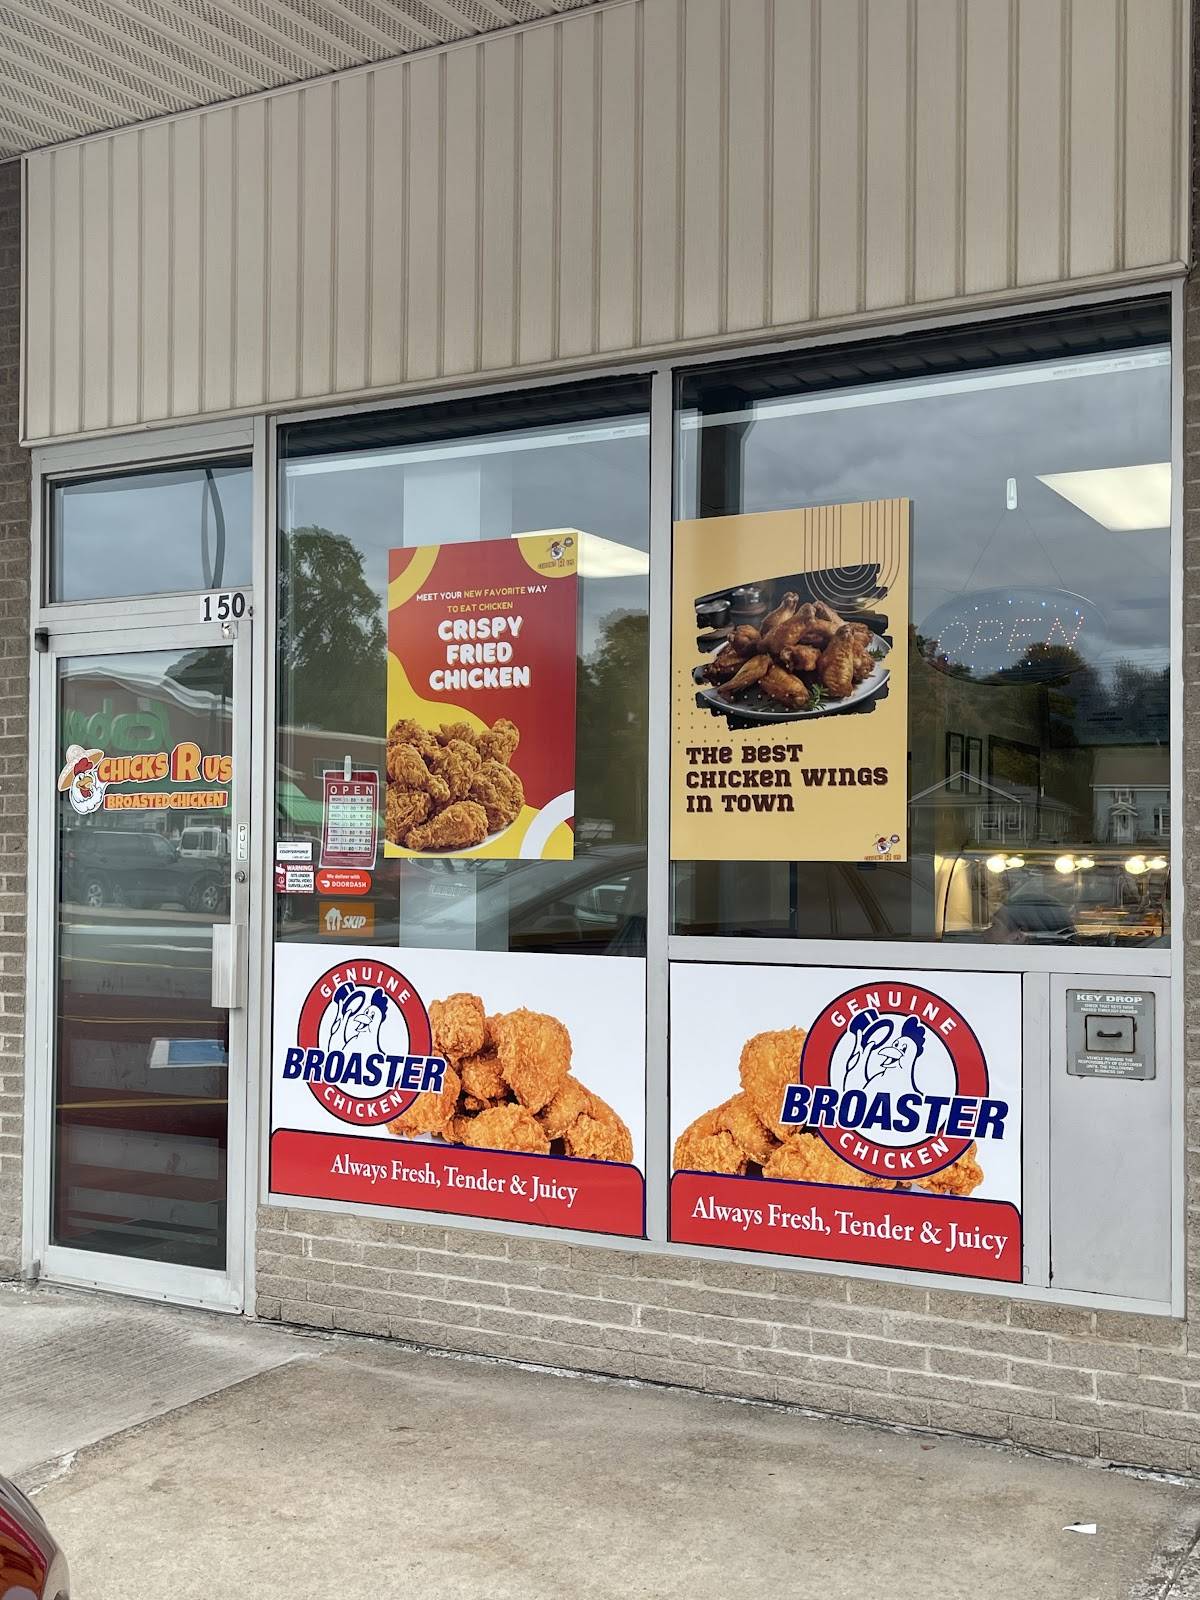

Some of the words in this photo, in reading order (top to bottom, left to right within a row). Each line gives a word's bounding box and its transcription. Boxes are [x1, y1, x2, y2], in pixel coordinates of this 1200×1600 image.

[203, 592, 246, 622] 150
[416, 592, 438, 602] MEET
[440, 590, 462, 600] YOUR
[463, 589, 482, 598] NEW
[484, 586, 526, 597] FAVORITE
[527, 584, 548, 594] WAY
[447, 605, 459, 613] TO
[460, 603, 477, 612] EAT
[479, 601, 514, 611] CHICKEN
[437, 615, 524, 641] CRISPY
[937, 616, 1085, 655] OPEN
[446, 641, 513, 665] FRIED
[429, 665, 532, 691] CHICKEN
[98, 753, 169, 783] CHICKS
[171, 743, 201, 782] R
[203, 756, 232, 783] US
[106, 794, 169, 809] BROASTED
[170, 793, 226, 808] CHICKEN
[330, 785, 373, 795] OPEN
[342, 915, 367, 929] SKIP
[320, 966, 411, 1005] GENUINE
[1105, 995, 1143, 1003] DROP
[830, 991, 957, 1035] GENUINE
[282, 1047, 446, 1092] BROASTER
[324, 1086, 403, 1118] CHICKEN
[781, 1085, 1009, 1140] BROASTER
[839, 1132, 950, 1169] CHICKEN
[330, 1153, 388, 1185] Always
[390, 1159, 441, 1188] Fresh,
[443, 1166, 505, 1195] Tender
[509, 1177, 527, 1196] &
[529, 1176, 579, 1208] Juicy
[691, 1196, 763, 1231] Always
[767, 1204, 832, 1236] Fresh,
[833, 1210, 915, 1242] Tender
[919, 1221, 942, 1245] &
[945, 1222, 1009, 1259] Juicy
